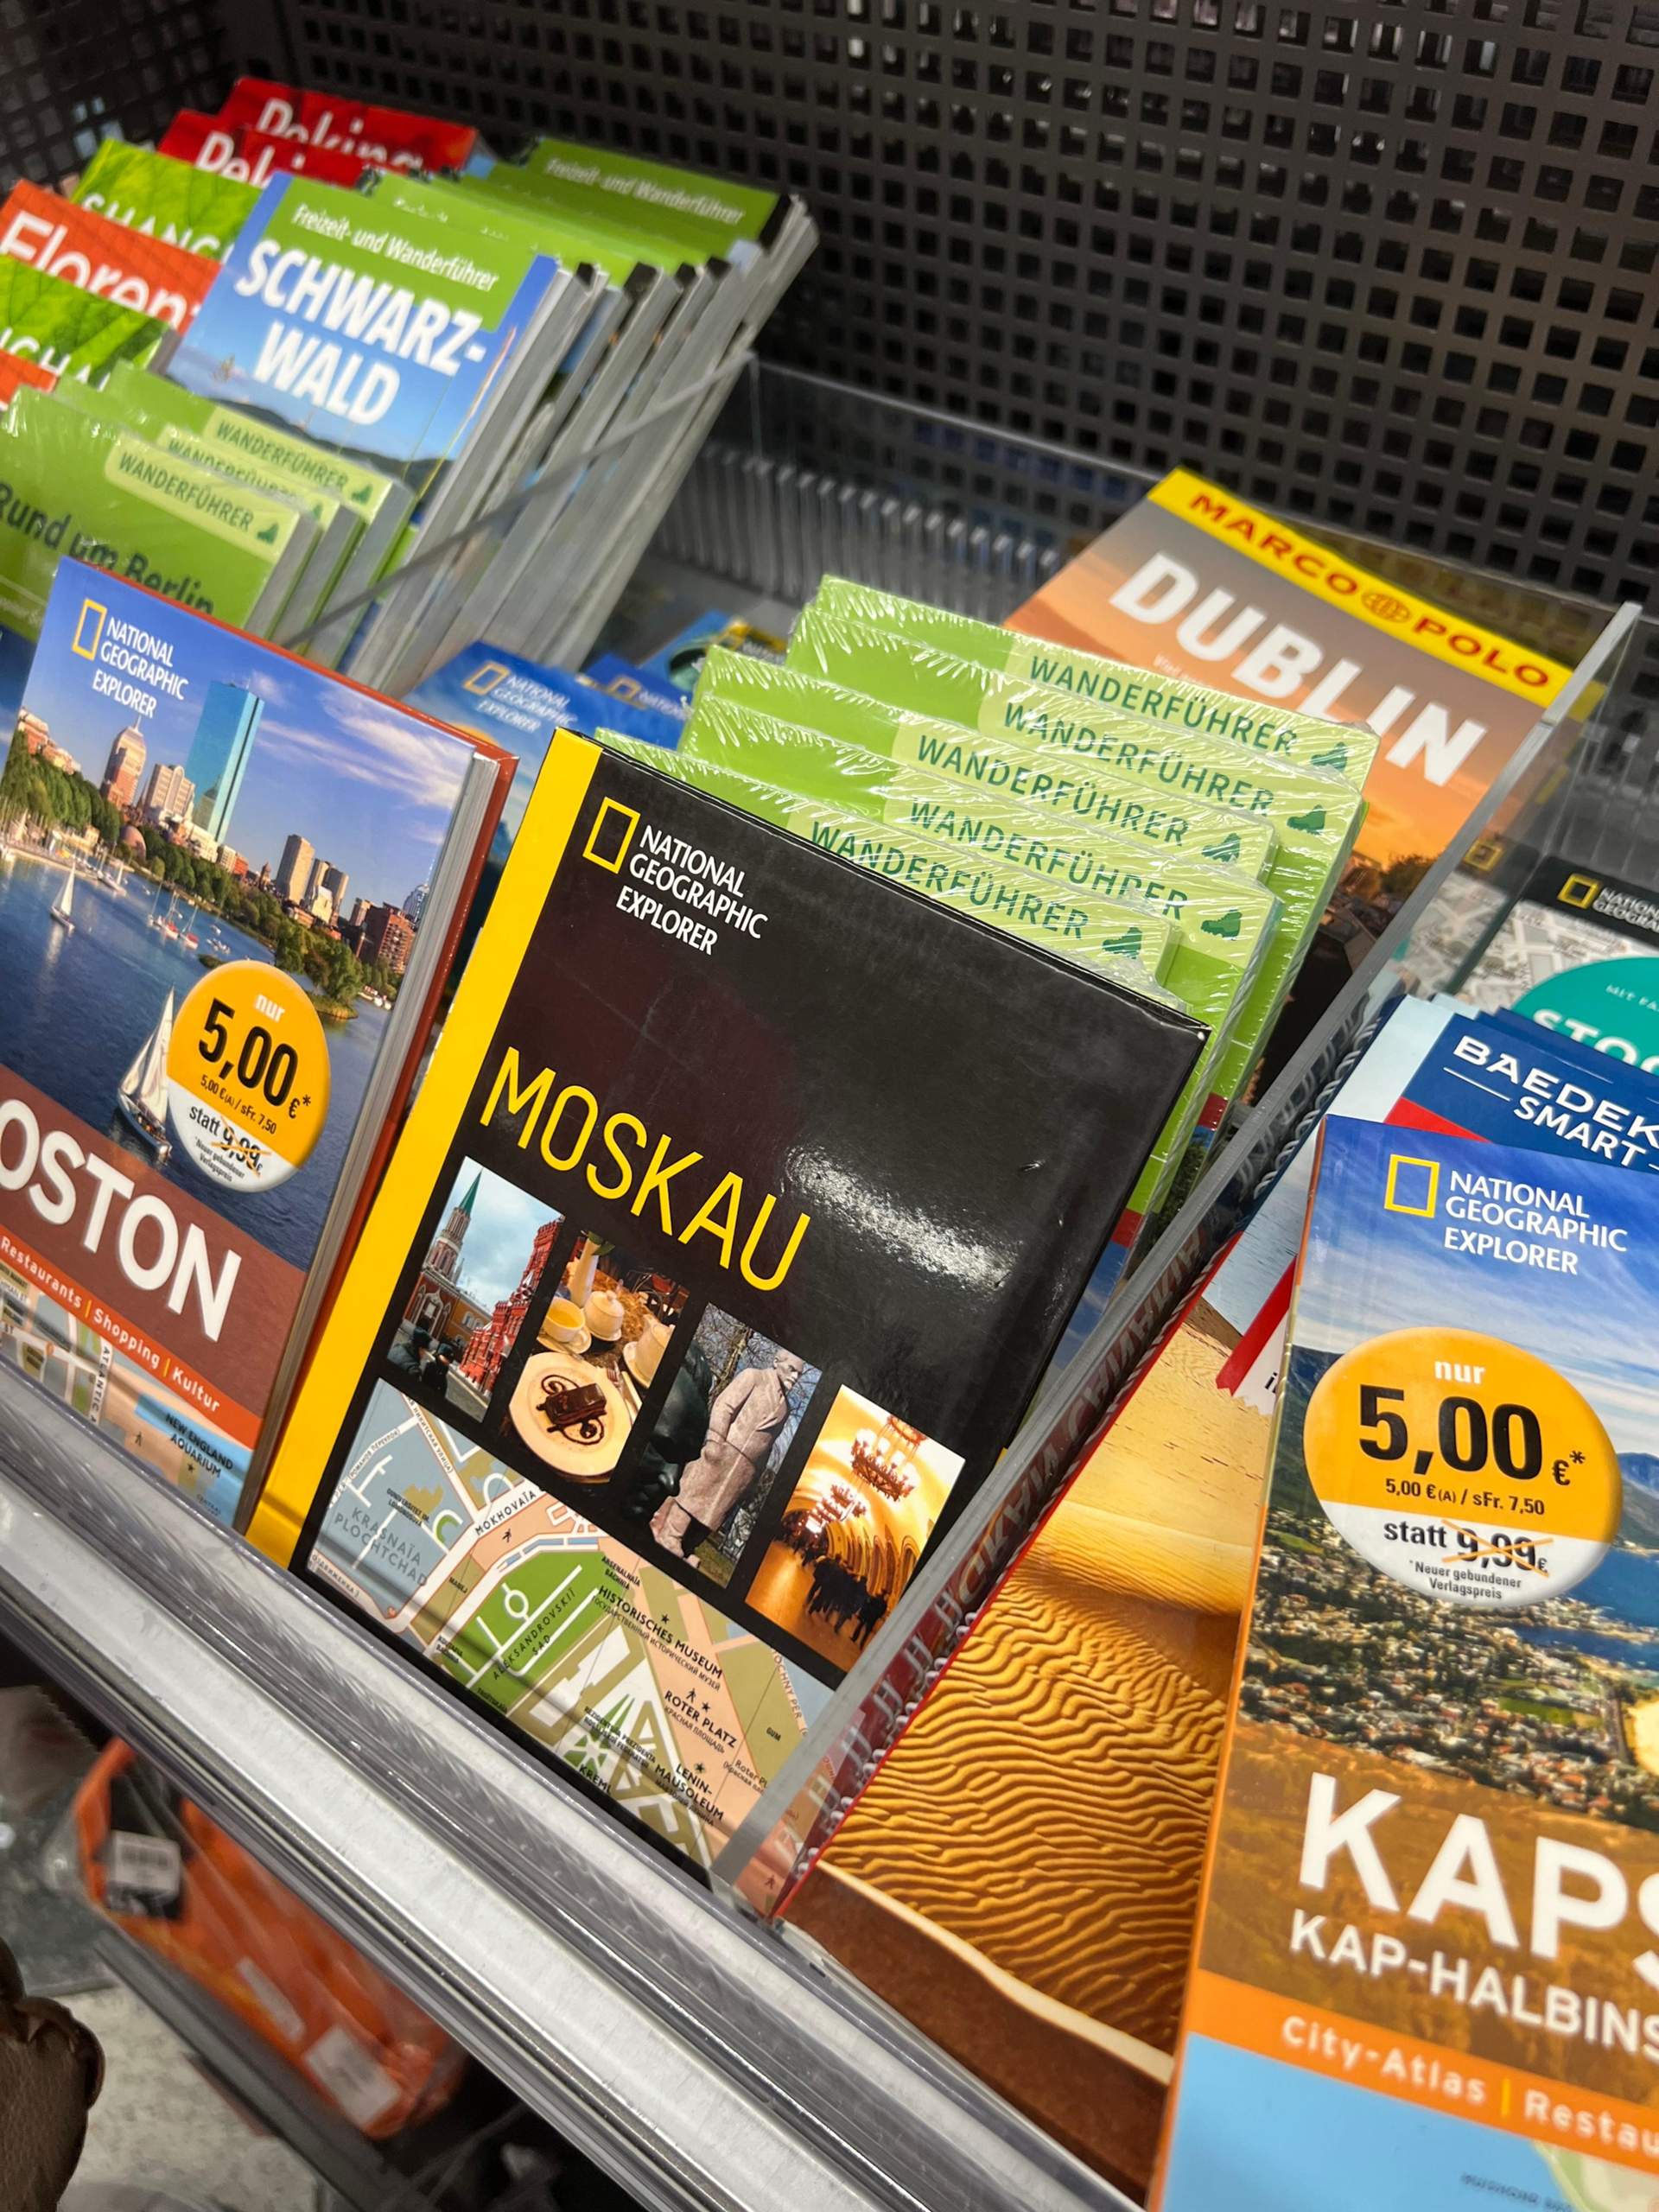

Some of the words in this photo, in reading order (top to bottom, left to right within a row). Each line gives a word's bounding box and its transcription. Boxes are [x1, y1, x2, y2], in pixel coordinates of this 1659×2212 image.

[633, 179, 747, 226] Wanderführer
[0, 210, 201, 330] Floren
[291, 203, 351, 241] Freizeit-
[351, 228, 389, 254] und
[386, 235, 500, 292] Wanderführer
[234, 238, 486, 377] SCHWARZ-
[253, 319, 401, 425] WALD
[216, 421, 352, 491] WANDERFÜHRER
[118, 452, 255, 533] WANDERFÜHRER
[68, 532, 119, 572] um
[124, 552, 214, 616] Berlin
[1189, 493, 1360, 596] MARCO
[1413, 617, 1549, 690] POLO
[100, 640, 189, 701] GEOGRAPHIC
[106, 617, 175, 667] NATIONAL
[1108, 550, 1489, 787] DUBLIN
[92, 668, 157, 719] EXPLORER
[474, 701, 542, 732] EXPLORER
[506, 675, 571, 708] NATIONAL
[1030, 655, 1298, 757] WANDERFÜHRER
[1004, 702, 1275, 817] WANDERFÜHRER
[918, 734, 1190, 848] WANDERFÜHRER
[639, 824, 746, 899] NATIONAL
[810, 820, 1090, 940] WANDERFÜHRER
[910, 799, 1189, 921] WANDERFÜHRER
[615, 885, 719, 956] EXPLORER
[629, 853, 769, 940] GEOGRAPHIC
[253, 994, 286, 1024] nur
[198, 996, 299, 1108] 5,00
[188, 1104, 222, 1138] statt
[200, 1074, 219, 1096] 5,00
[257, 1112, 277, 1136] 7,50
[1512, 1095, 1647, 1168] SMART
[479, 1045, 812, 1292] MOSKAU
[1449, 1169, 1591, 1219] NATIONAL
[1443, 1225, 1579, 1275] EXPLORER
[1445, 1195, 1629, 1253] GEOGRAPHIC
[0, 1235, 84, 1309] Restaurants
[93, 1307, 162, 1370] Shopping
[172, 1367, 221, 1414] Kultur
[1433, 1360, 1486, 1385] nur
[164, 1412, 188, 1438] NEW
[188, 1427, 234, 1471] ENGLAND
[169, 1433, 222, 1479] AQUARIUM
[1358, 1382, 1543, 1481] 5,00
[474, 1489, 538, 1537] MOKHOVAÏA
[1385, 1477, 1421, 1497] 5,00
[1471, 1490, 1504, 1510] sFr.
[1508, 1494, 1545, 1516] 7,50
[334, 1512, 429, 1587] PLOCHTCHAD
[351, 1507, 423, 1566] KRASNAÏA
[1382, 1520, 1448, 1548] statt
[1428, 1577, 1503, 1600] Verlagspreis
[1452, 1567, 1522, 1589] gebundener
[531, 1634, 552, 1656] SAD
[598, 1585, 674, 1644] HISTORISCHES
[674, 1639, 724, 1680] MUSEUM
[649, 1637, 699, 1676] ИСТОРИЧЕСКИЙ
[698, 1668, 722, 1693] МУЗЕЙ
[663, 1705, 696, 1733] КРАСНАЯ
[692, 1726, 726, 1755] ПЛОЩАДЬ
[664, 1689, 701, 1723] ROTER
[702, 1717, 737, 1750] PLATZ
[766, 1726, 782, 1743] GUM
[654, 1764, 725, 1822] MAUSOLEUM
[675, 1763, 714, 1796] LENIN-
[734, 1758, 760, 1783] Roter
[1281, 2015, 1486, 2107] City-Atlas
